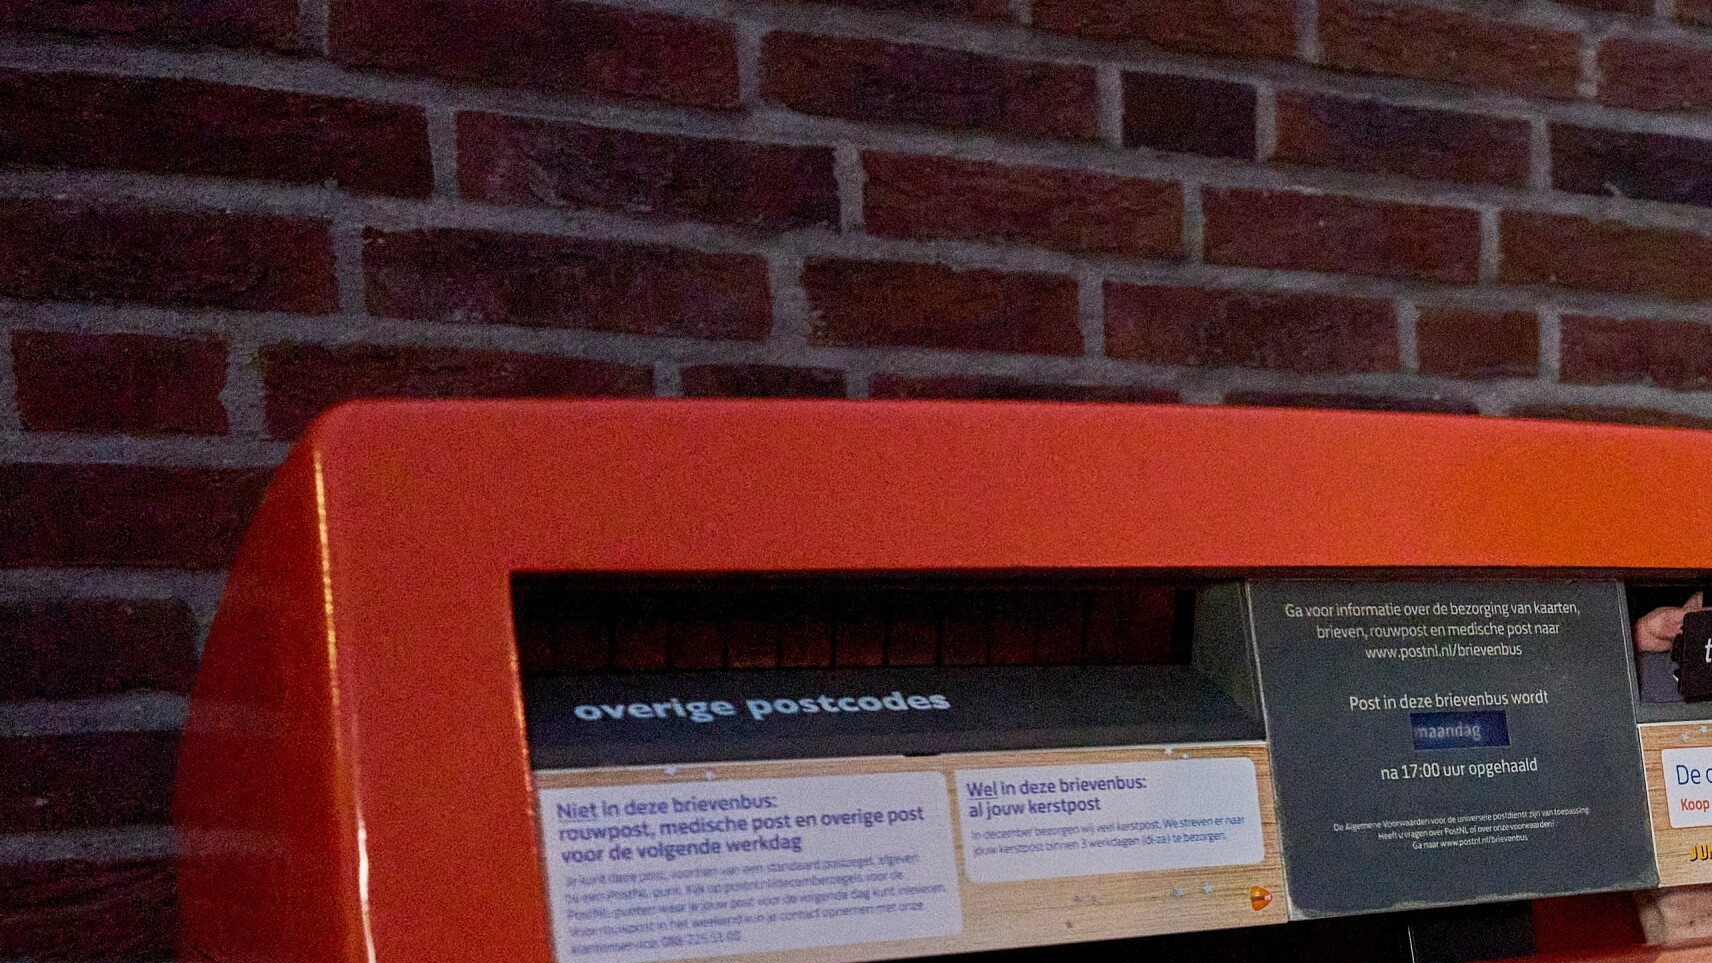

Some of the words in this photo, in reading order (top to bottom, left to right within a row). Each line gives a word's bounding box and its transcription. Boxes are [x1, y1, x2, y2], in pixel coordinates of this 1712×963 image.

[1285, 603, 1303, 618] Ga
[1304, 605, 1334, 617] voor
[1336, 602, 1401, 617] informatie
[1403, 605, 1431, 616] over
[1433, 602, 1448, 616] de
[1450, 602, 1510, 619] bezorging
[1510, 604, 1532, 615] van
[1534, 601, 1581, 616] kaarten,
[1317, 625, 1368, 641] brieven,
[1370, 624, 1428, 640] rouwpost
[1430, 626, 1446, 637] en
[1448, 622, 1505, 636] medische
[1507, 623, 1533, 638] post
[1535, 624, 1560, 635] naar
[1365, 643, 1523, 661] www.postnl.nl/brievenbus
[574, 698, 736, 723] overige
[746, 691, 952, 721] postcodes
[1349, 695, 1381, 711] Post
[1383, 695, 1397, 710] in
[1400, 693, 1433, 709] deze
[1435, 691, 1509, 708] brievenbus
[1511, 689, 1549, 705] wordt
[1414, 722, 1481, 741] maandag
[1381, 767, 1399, 780] na
[1401, 762, 1440, 779] 17:00
[1443, 764, 1466, 777] uur
[1468, 757, 1538, 778] opgehaald
[1675, 764, 1701, 786] De
[966, 781, 998, 798] Wel
[1001, 780, 1016, 796] in
[1020, 778, 1056, 795] deze
[1059, 775, 1147, 793] brievenbus:
[557, 802, 598, 820] Niet
[602, 800, 620, 817] in
[624, 799, 668, 816] deze
[672, 795, 778, 813] brievenbus:
[969, 802, 983, 818] al
[986, 800, 1025, 820] jouw
[1028, 797, 1102, 816] kerstpost
[1680, 797, 1710, 813] Koop
[559, 822, 655, 842] rouwpost,
[660, 815, 748, 835] medische
[752, 815, 791, 833] post
[796, 814, 818, 828] en
[821, 808, 883, 828] overige
[888, 806, 924, 826] post
[983, 827, 1032, 840] december
[1035, 825, 1080, 839] bezorgen
[1162, 818, 1179, 829] We
[1179, 817, 1214, 828] streven
[1214, 817, 1224, 827] er
[1225, 815, 1245, 826] naar
[1333, 822, 1344, 832] De
[1382, 817, 1430, 829] Voorwaarden
[1378, 831, 1397, 841] Heeft
[1403, 829, 1429, 842] vragen
[1429, 828, 1444, 838] over
[1444, 825, 1469, 837] PostNL
[1477, 825, 1493, 834] over
[561, 849, 603, 864] voor
[609, 843, 633, 861] de
[637, 838, 721, 862] volgende
[726, 834, 803, 854] werkdag
[998, 842, 1044, 856] kerstpost
[1045, 839, 1079, 852] binnen
[1081, 838, 1088, 849] 3
[1089, 836, 1140, 850] werkdagen
[1172, 833, 1182, 844] te
[1412, 840, 1423, 850] Ga
[1423, 839, 1440, 849] naar
